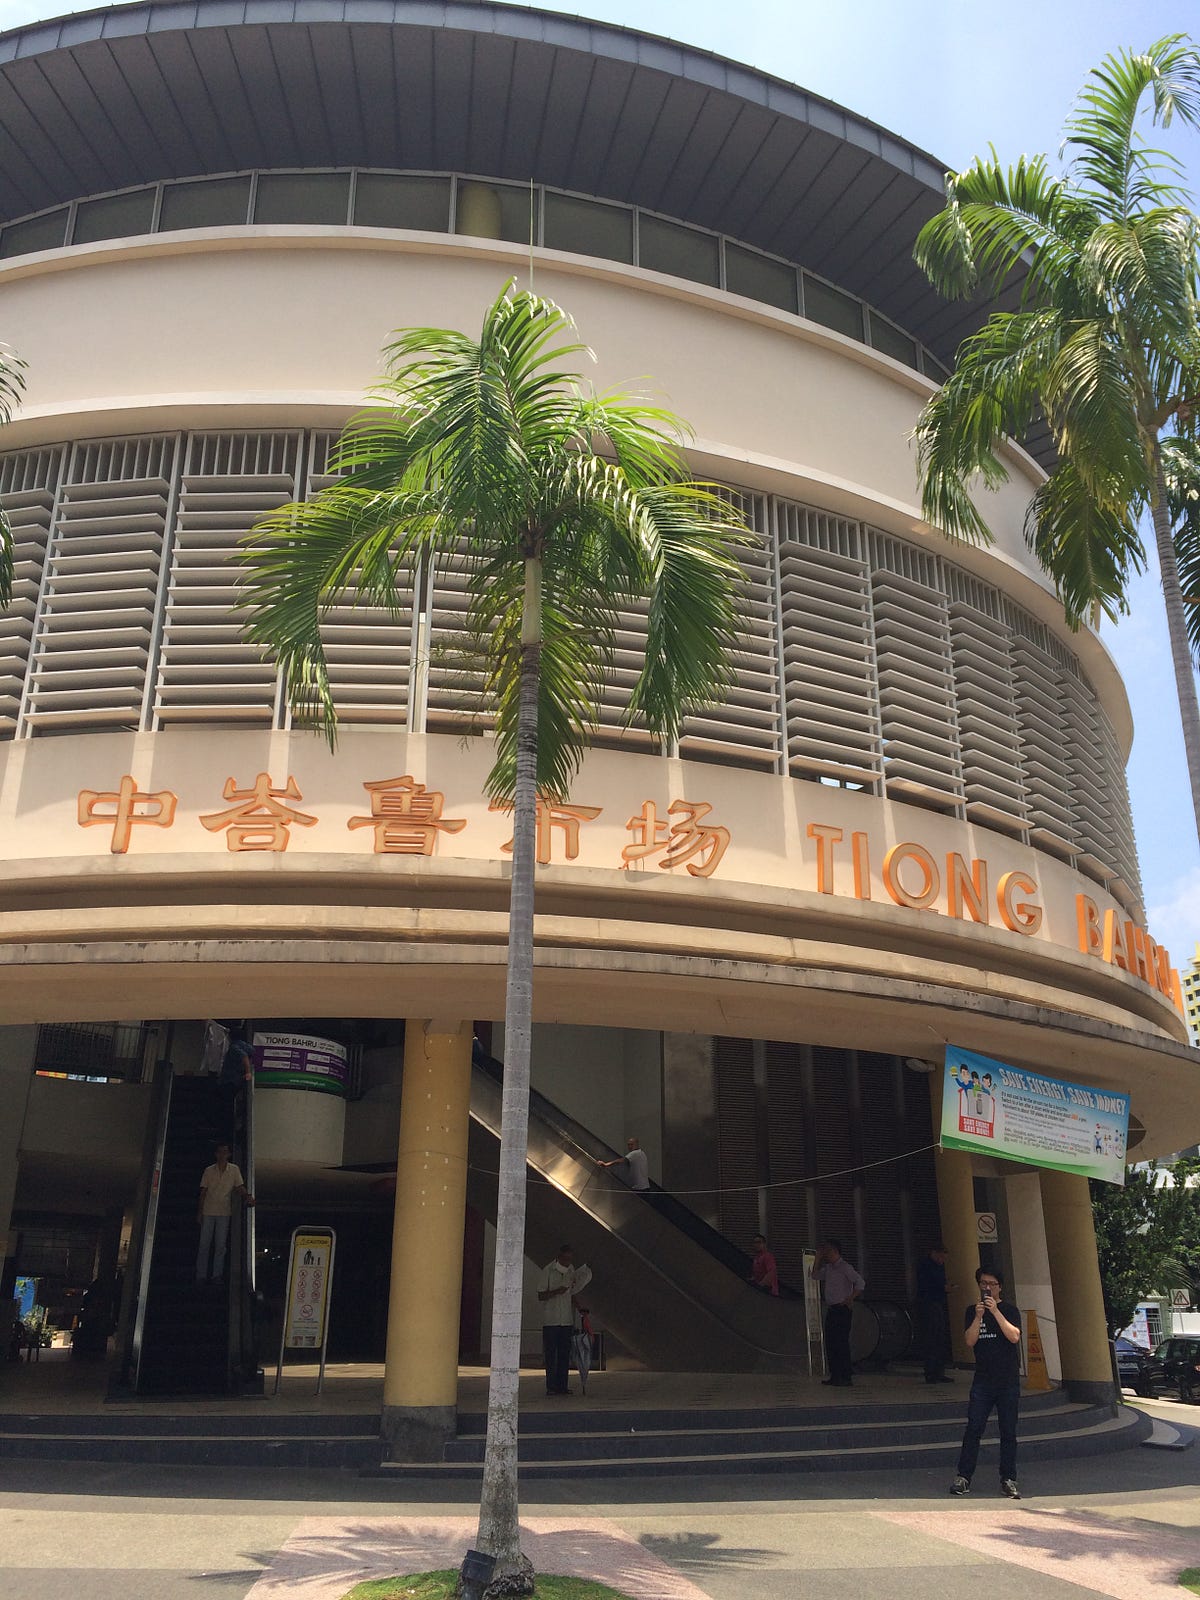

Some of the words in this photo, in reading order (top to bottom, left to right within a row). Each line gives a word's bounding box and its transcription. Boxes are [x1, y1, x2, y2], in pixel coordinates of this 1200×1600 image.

[806, 823, 1043, 935] TIONG
[1076, 894, 1174, 1004] BAHRU
[265, 1036, 290, 1045] TIONG
[292, 1038, 318, 1048] BAHRU
[998, 1068, 1028, 1091] SAVE
[1067, 1087, 1095, 1109] SAVE
[1094, 1093, 1127, 1116] MONEY
